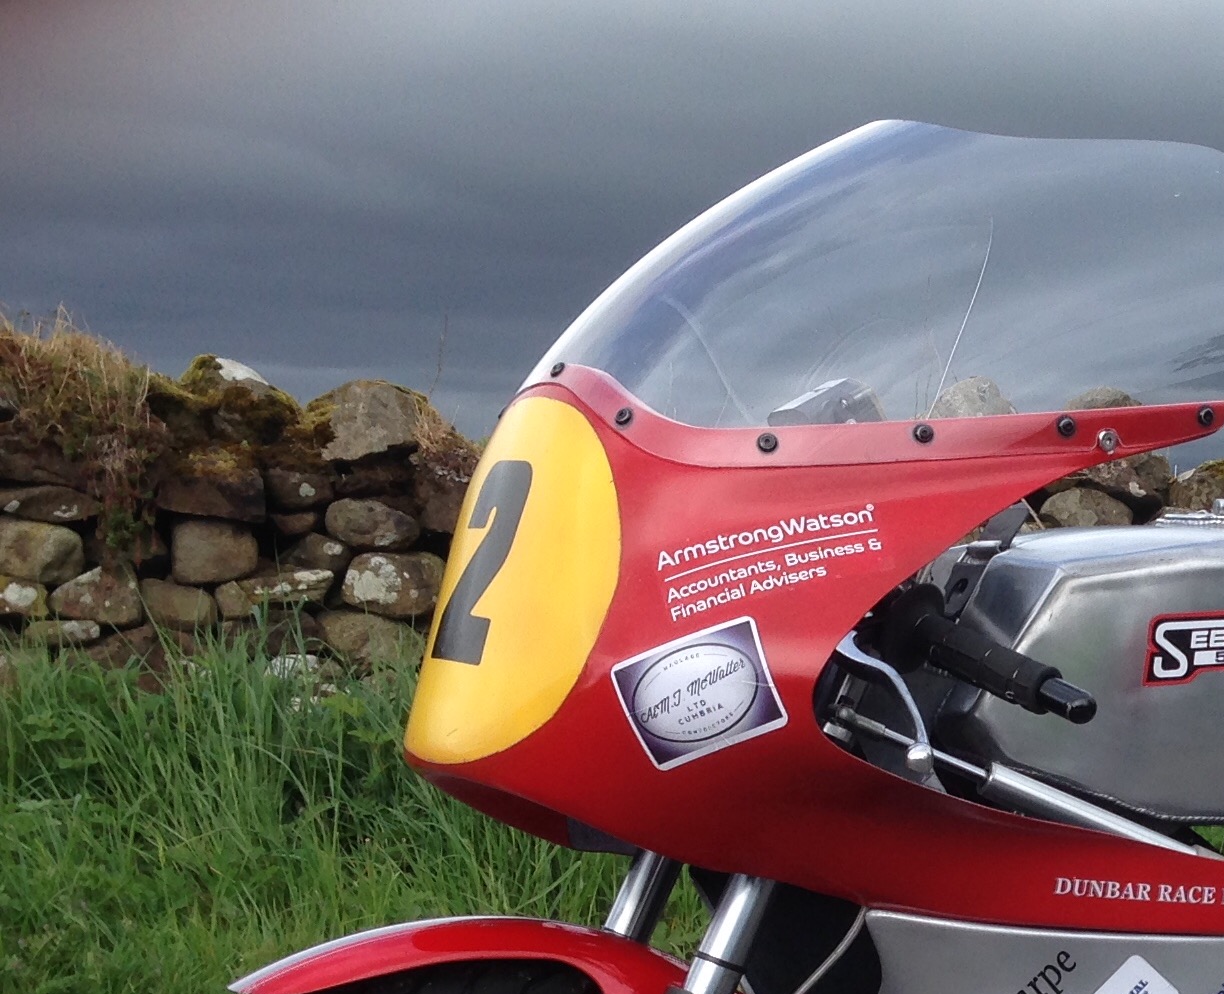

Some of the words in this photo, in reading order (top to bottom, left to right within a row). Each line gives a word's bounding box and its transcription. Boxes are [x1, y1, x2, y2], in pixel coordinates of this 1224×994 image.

[431, 460, 534, 667] 2
[667, 559, 781, 603] Accountants,
[785, 543, 865, 567] Business
[868, 538, 882, 550] &
[670, 584, 746, 622] Financial
[750, 565, 827, 594] Advisers
[678, 703, 724, 725] CUMBRIA
[687, 700, 706, 712] LTD
[1054, 877, 1151, 901] DUNBAR
[1157, 884, 1216, 904] RACE
